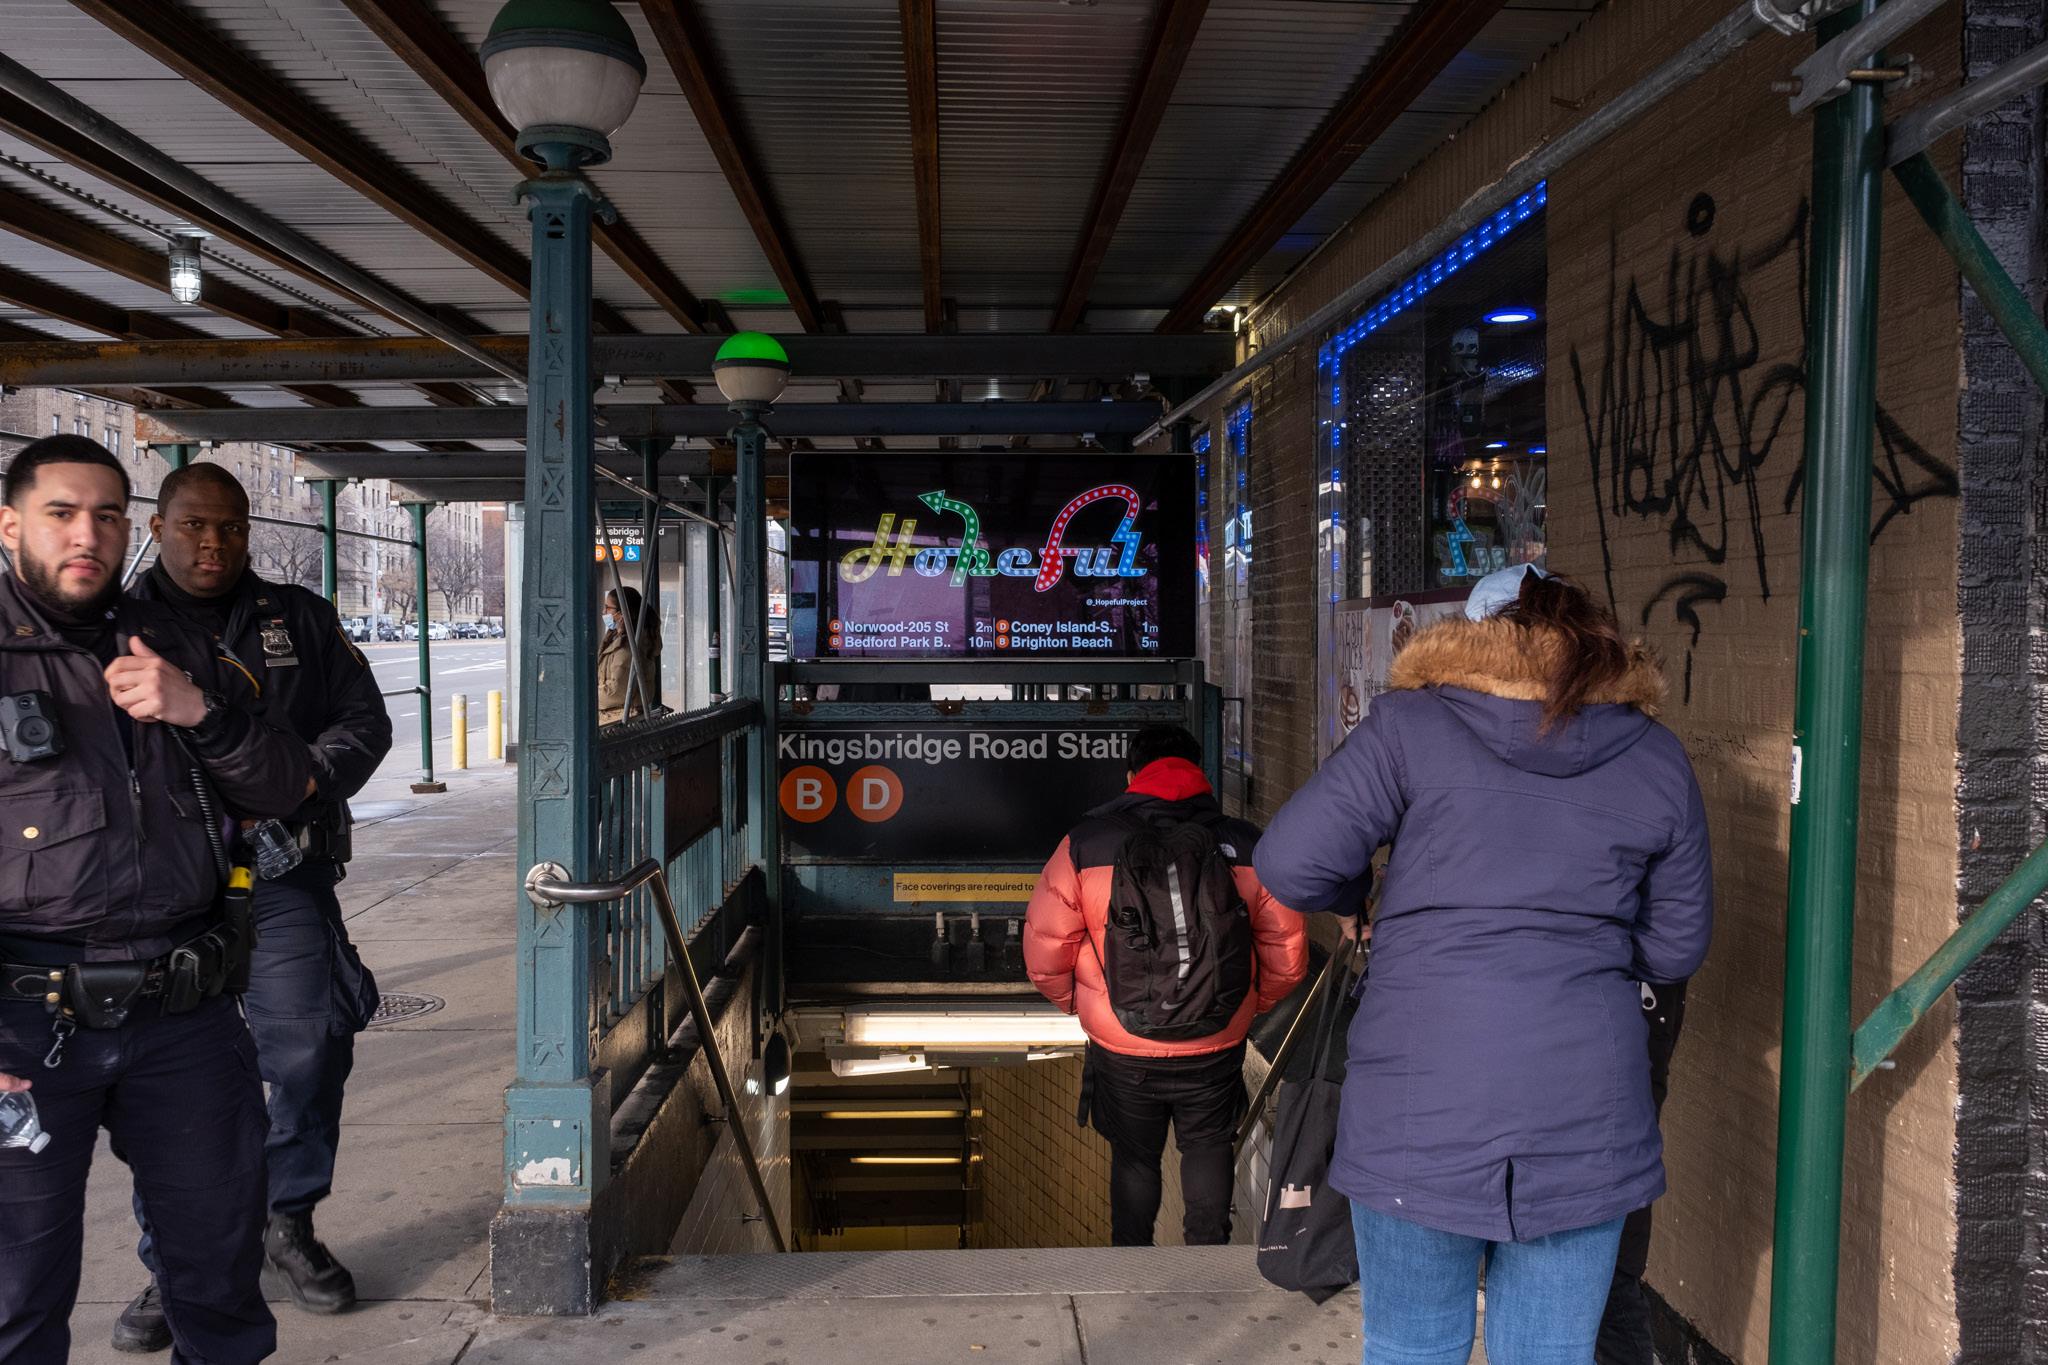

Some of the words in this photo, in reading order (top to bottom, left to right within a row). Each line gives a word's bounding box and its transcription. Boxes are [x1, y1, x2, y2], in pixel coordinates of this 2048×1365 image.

[626, 537, 644, 545] Stat
[840, 484, 1147, 592] Hopeful
[768, 603, 788, 615] dEx
[1086, 599, 1148, 607] @_HopefulProject
[844, 621, 931, 633] Norwood-205
[935, 621, 949, 633] St
[975, 621, 993, 633] 2m
[1011, 621, 1053, 635] Coney
[1057, 621, 1117, 633] Island-S..
[1142, 621, 1158, 633] 1m
[844, 636, 897, 648] Bedford
[900, 636, 930, 648] Park
[934, 636, 951, 648] B..
[968, 636, 993, 648] 10m
[1011, 636, 1068, 650] Brighton
[1072, 636, 1113, 648] Beach
[1141, 636, 1158, 648] 5m
[778, 733, 961, 765] Kingsbridge
[969, 732, 1048, 760] Road
[1057, 732, 1128, 760] Stati
[796, 778, 823, 810] B
[862, 778, 890, 810] D
[896, 882, 919, 891] Face
[920, 882, 966, 892] coverings
[967, 883, 982, 891] are
[984, 882, 1023, 892] required
[1024, 883, 1034, 891] to
